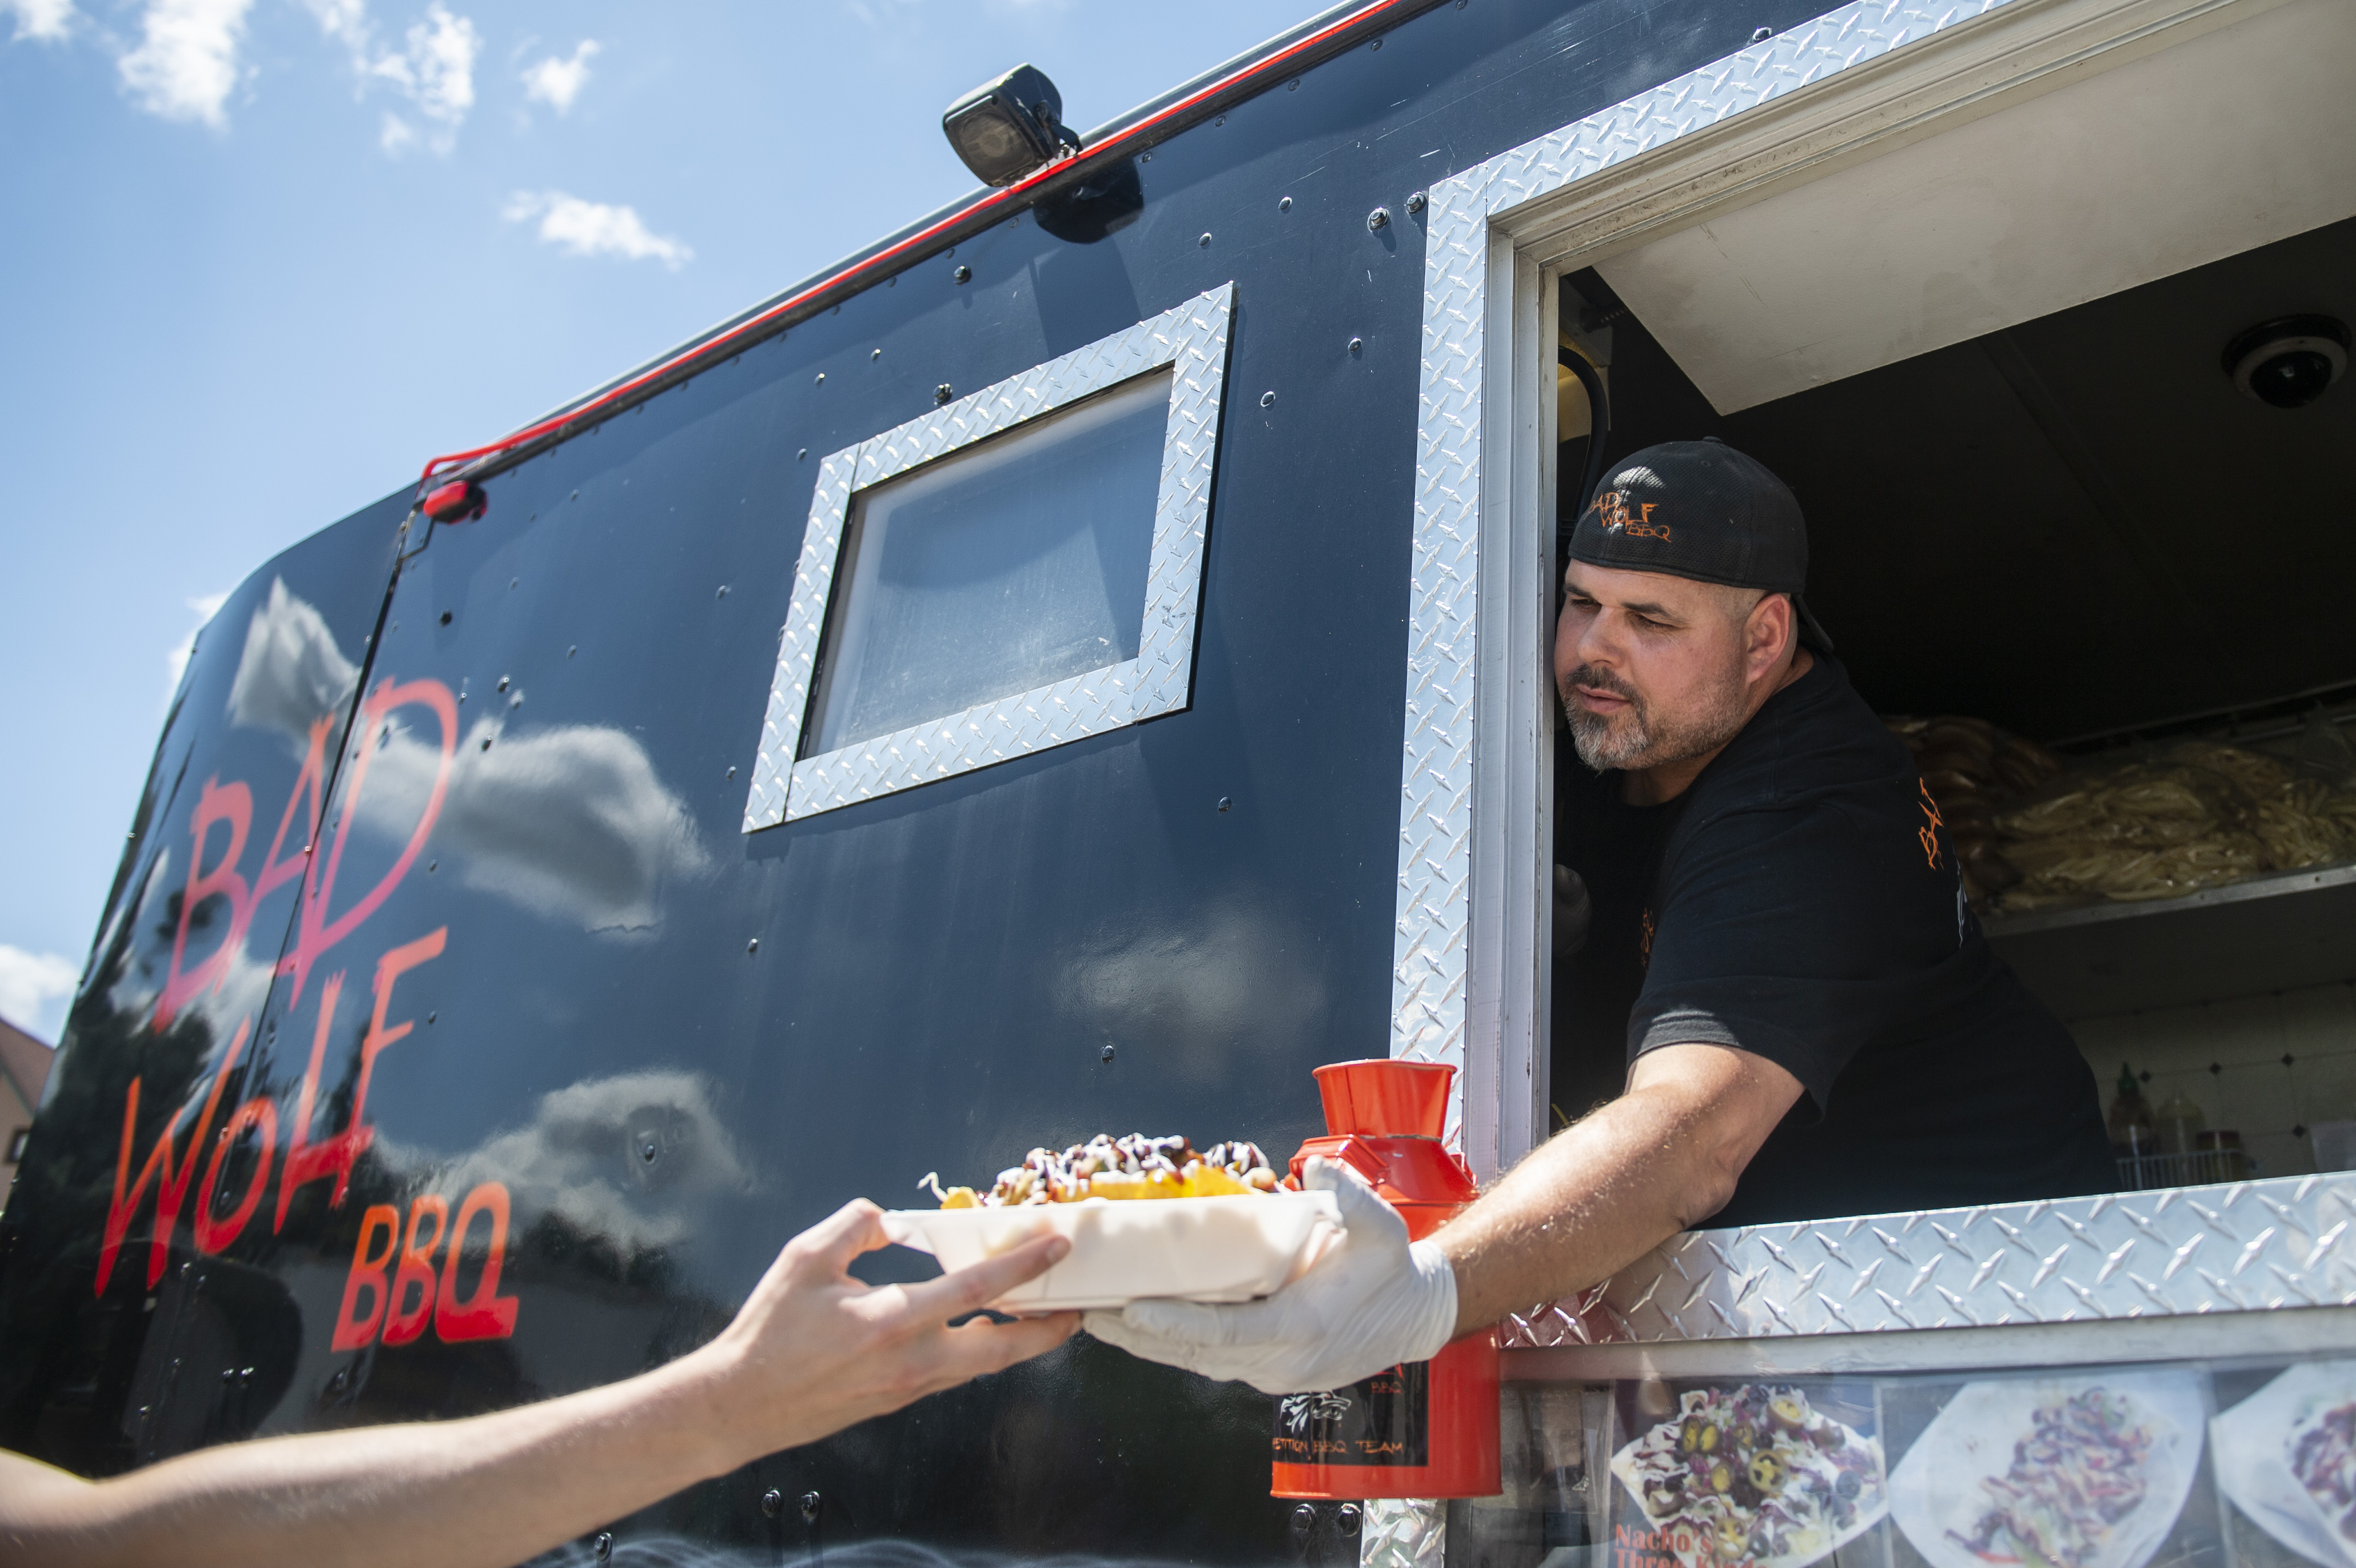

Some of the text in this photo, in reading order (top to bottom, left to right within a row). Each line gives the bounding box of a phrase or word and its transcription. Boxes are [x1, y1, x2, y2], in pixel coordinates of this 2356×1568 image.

[1583, 492, 1622, 520] AD
[1625, 521, 1672, 542] BBQ
[153, 676, 458, 1035] BAD
[94, 925, 448, 1299] WOLF
[331, 1180, 520, 1353] BBQ
[1371, 1381, 1401, 1394] BBQ
[1313, 1439, 1349, 1454] BBQ
[1355, 1440, 1404, 1455] TEAM
[1614, 1523, 1714, 1555] Nacho's
